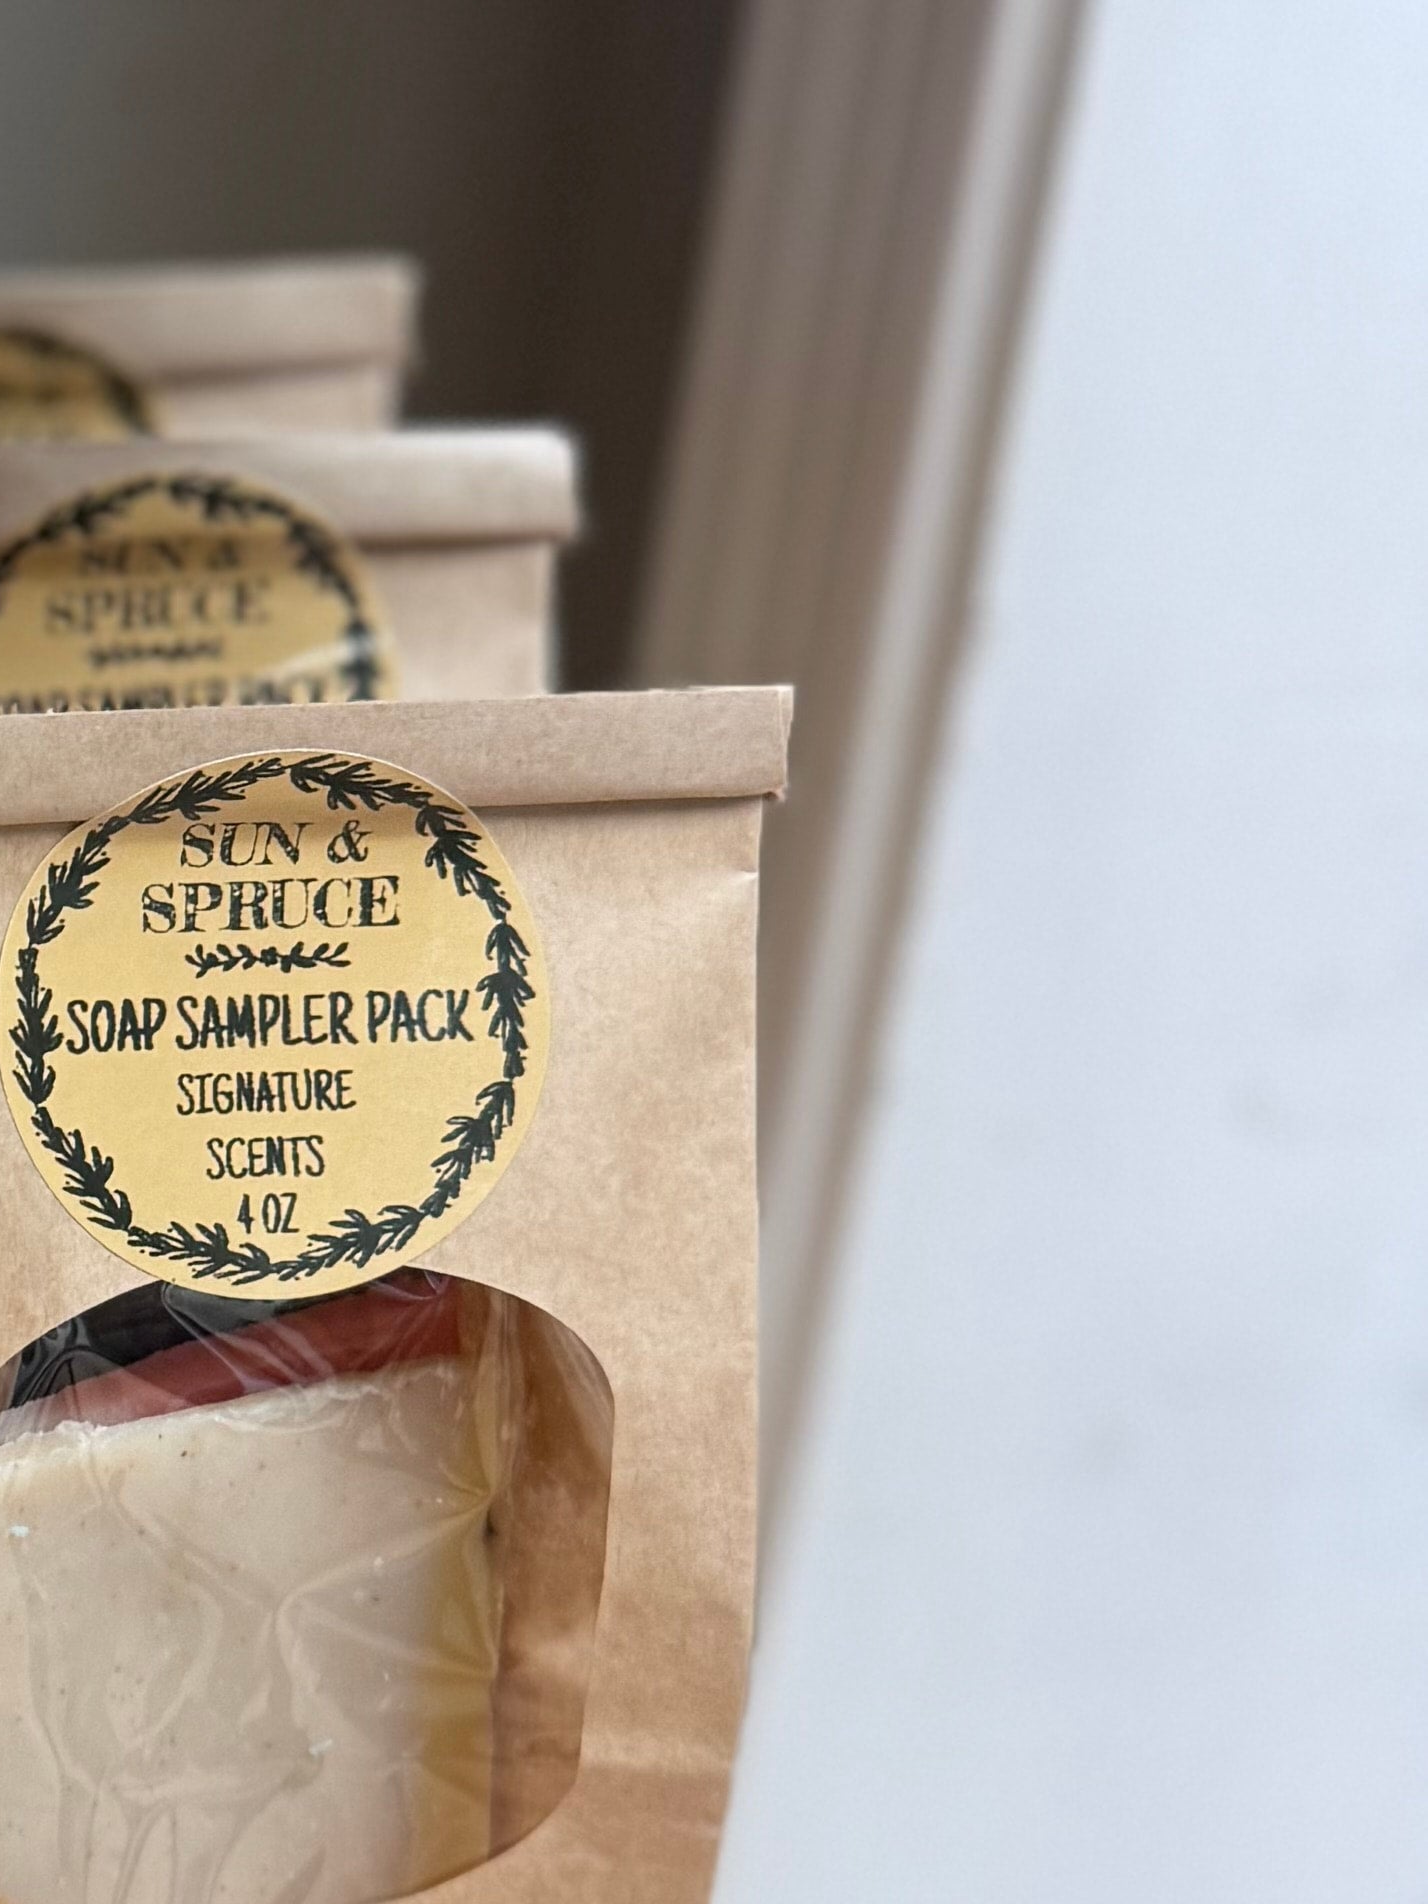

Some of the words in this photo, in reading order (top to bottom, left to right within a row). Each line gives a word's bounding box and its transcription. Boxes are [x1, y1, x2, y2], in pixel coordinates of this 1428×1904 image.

[180, 822, 304, 868] SUN
[327, 819, 374, 864] &
[141, 875, 400, 933] SPRUCE
[66, 998, 167, 1055] SOAP
[175, 991, 359, 1051] SAMPLER
[365, 989, 475, 1043] PACK
[176, 1068, 357, 1116] SIGNATURE
[206, 1135, 325, 1180] SCENTS
[237, 1193, 254, 1234] 4
[262, 1192, 300, 1234] OZ
